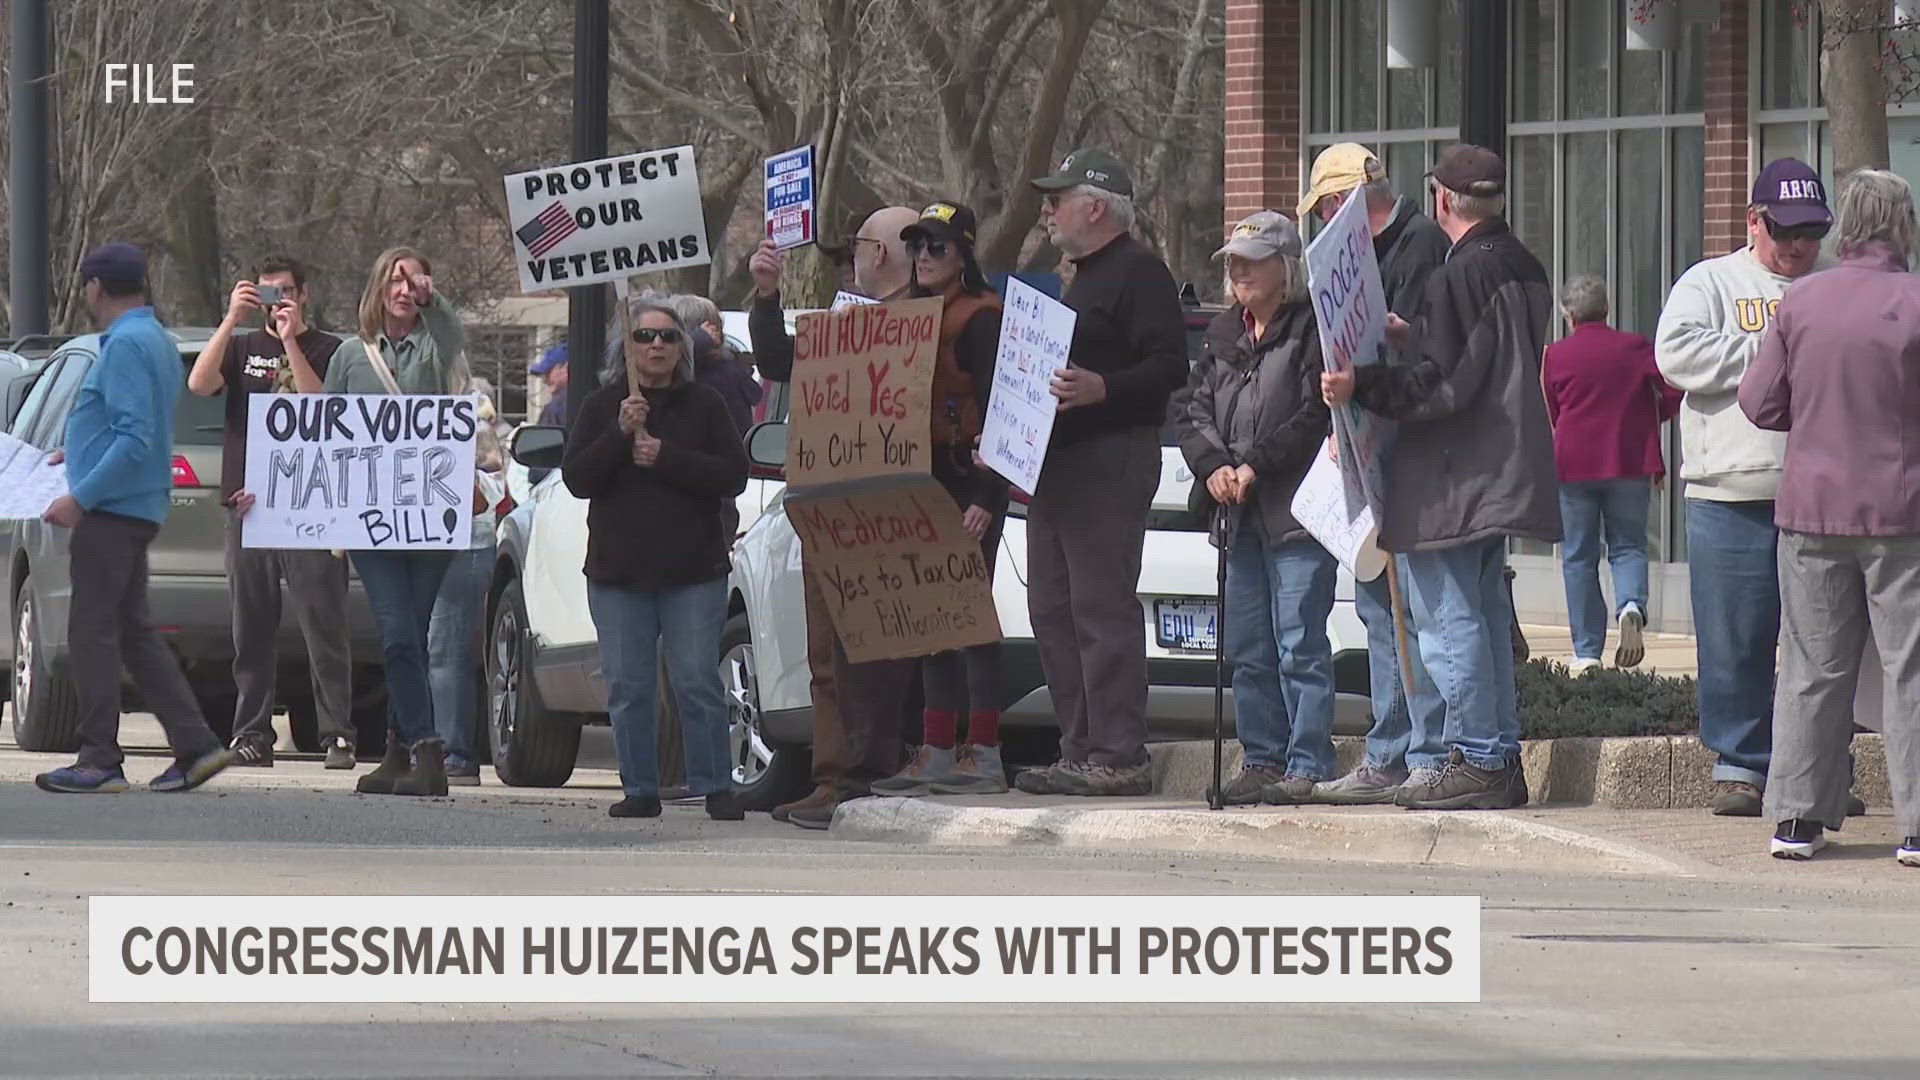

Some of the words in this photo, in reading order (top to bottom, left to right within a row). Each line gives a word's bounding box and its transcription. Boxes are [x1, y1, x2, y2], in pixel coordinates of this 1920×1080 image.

[525, 153, 679, 199] PROTECT
[575, 198, 643, 229] OUR
[528, 235, 699, 282] VETERANS
[796, 315, 830, 360] Bill
[243, 363, 267, 378] for
[246, 354, 281, 368] Med
[867, 360, 907, 420] Yes
[266, 397, 353, 442] OUR
[357, 398, 475, 442] VOICES
[796, 439, 815, 471] to
[829, 421, 867, 467] Cut
[878, 423, 918, 466] Your
[266, 445, 461, 511] MATTER
[358, 507, 457, 547] BILL!
[802, 492, 938, 552] Medicaid
[824, 564, 868, 607] Yes
[878, 564, 902, 590] to
[903, 553, 944, 586] Tax
